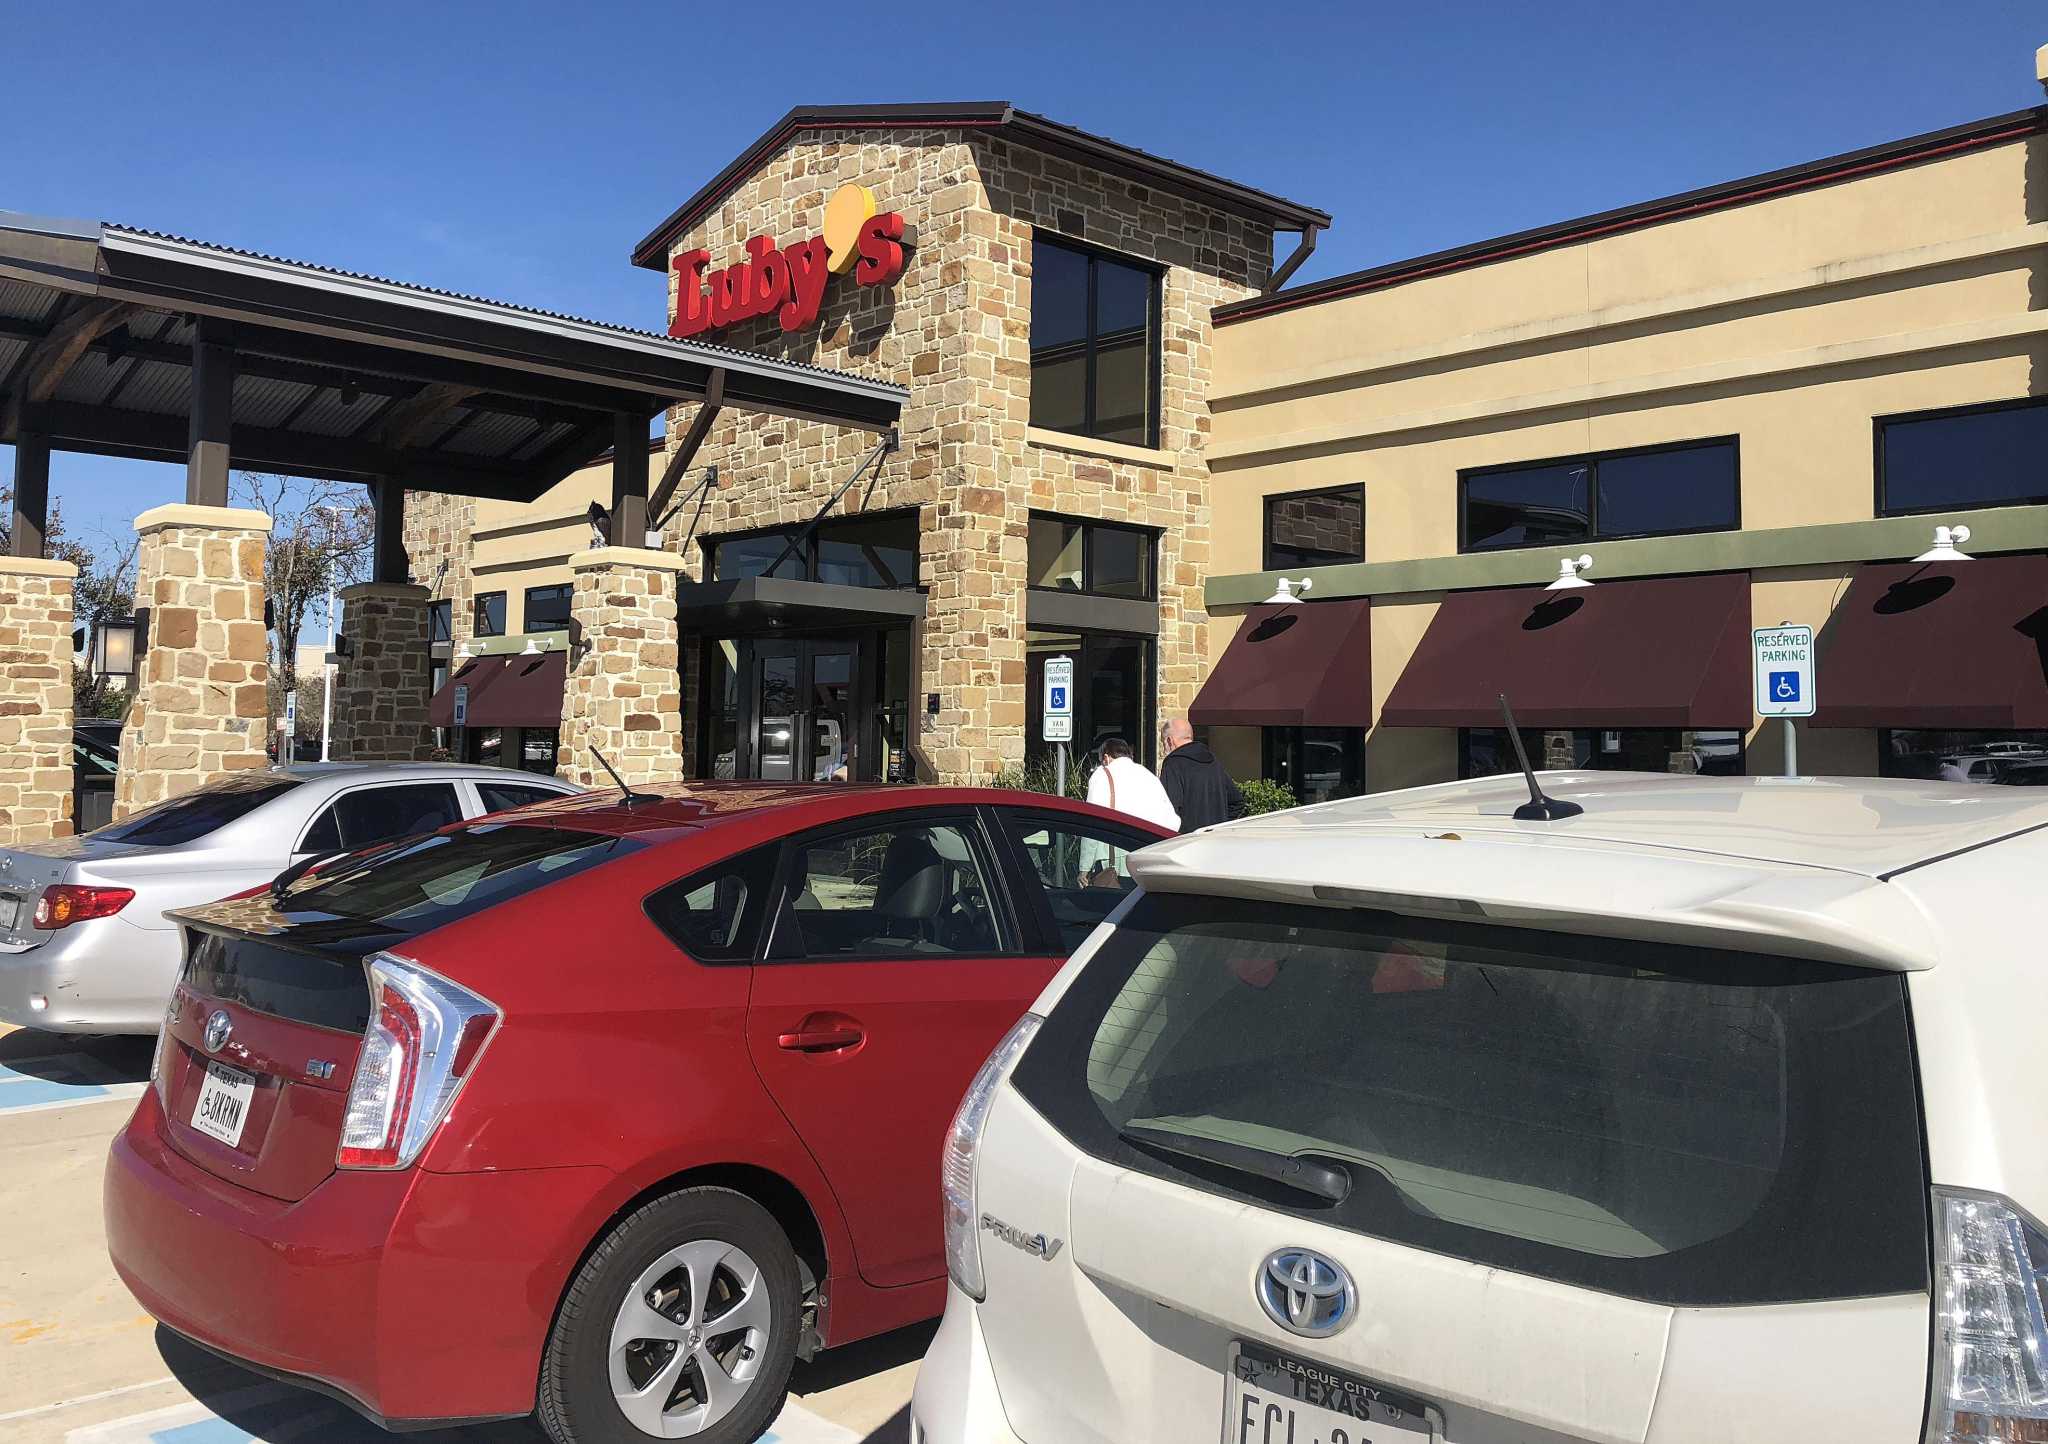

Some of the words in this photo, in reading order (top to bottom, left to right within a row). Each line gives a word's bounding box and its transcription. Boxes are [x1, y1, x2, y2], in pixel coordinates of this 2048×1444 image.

[668, 183, 904, 337] Luby's
[1757, 634, 1808, 647] RESERVED
[1762, 650, 1806, 662] PARKING
[1048, 676, 1069, 684] PARKING
[219, 1070, 239, 1089] TEXAS
[1277, 1357, 1340, 1389] LEAGUE
[1344, 1380, 1382, 1401] CITY
[1289, 1373, 1371, 1421] TEXAS
